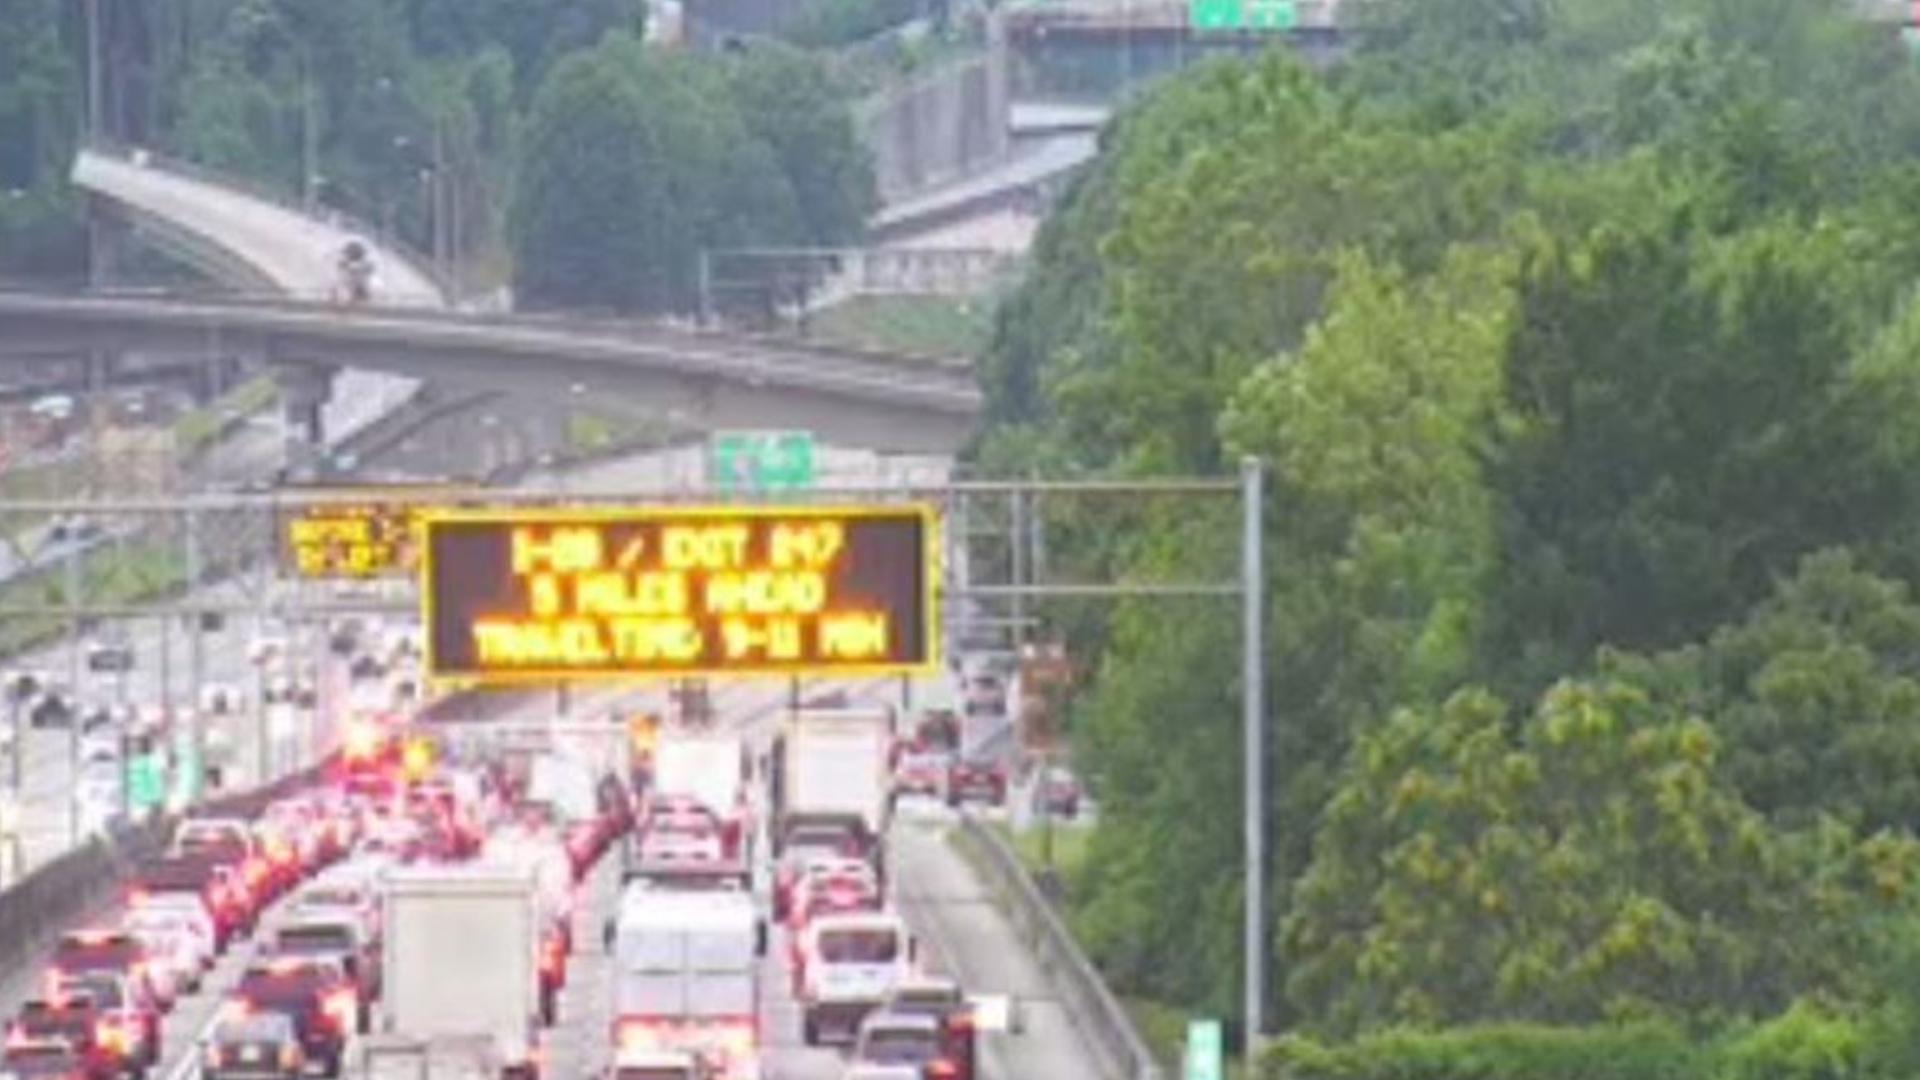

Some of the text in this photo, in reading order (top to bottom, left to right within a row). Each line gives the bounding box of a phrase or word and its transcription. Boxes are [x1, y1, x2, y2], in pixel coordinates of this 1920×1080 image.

[513, 527, 600, 573] I-
[662, 526, 747, 570] EXIT
[771, 521, 844, 569] 47
[577, 571, 686, 615] MILES
[707, 571, 824, 614] AHEAD
[473, 619, 608, 661] TRAVEL
[820, 613, 886, 657] MIN
